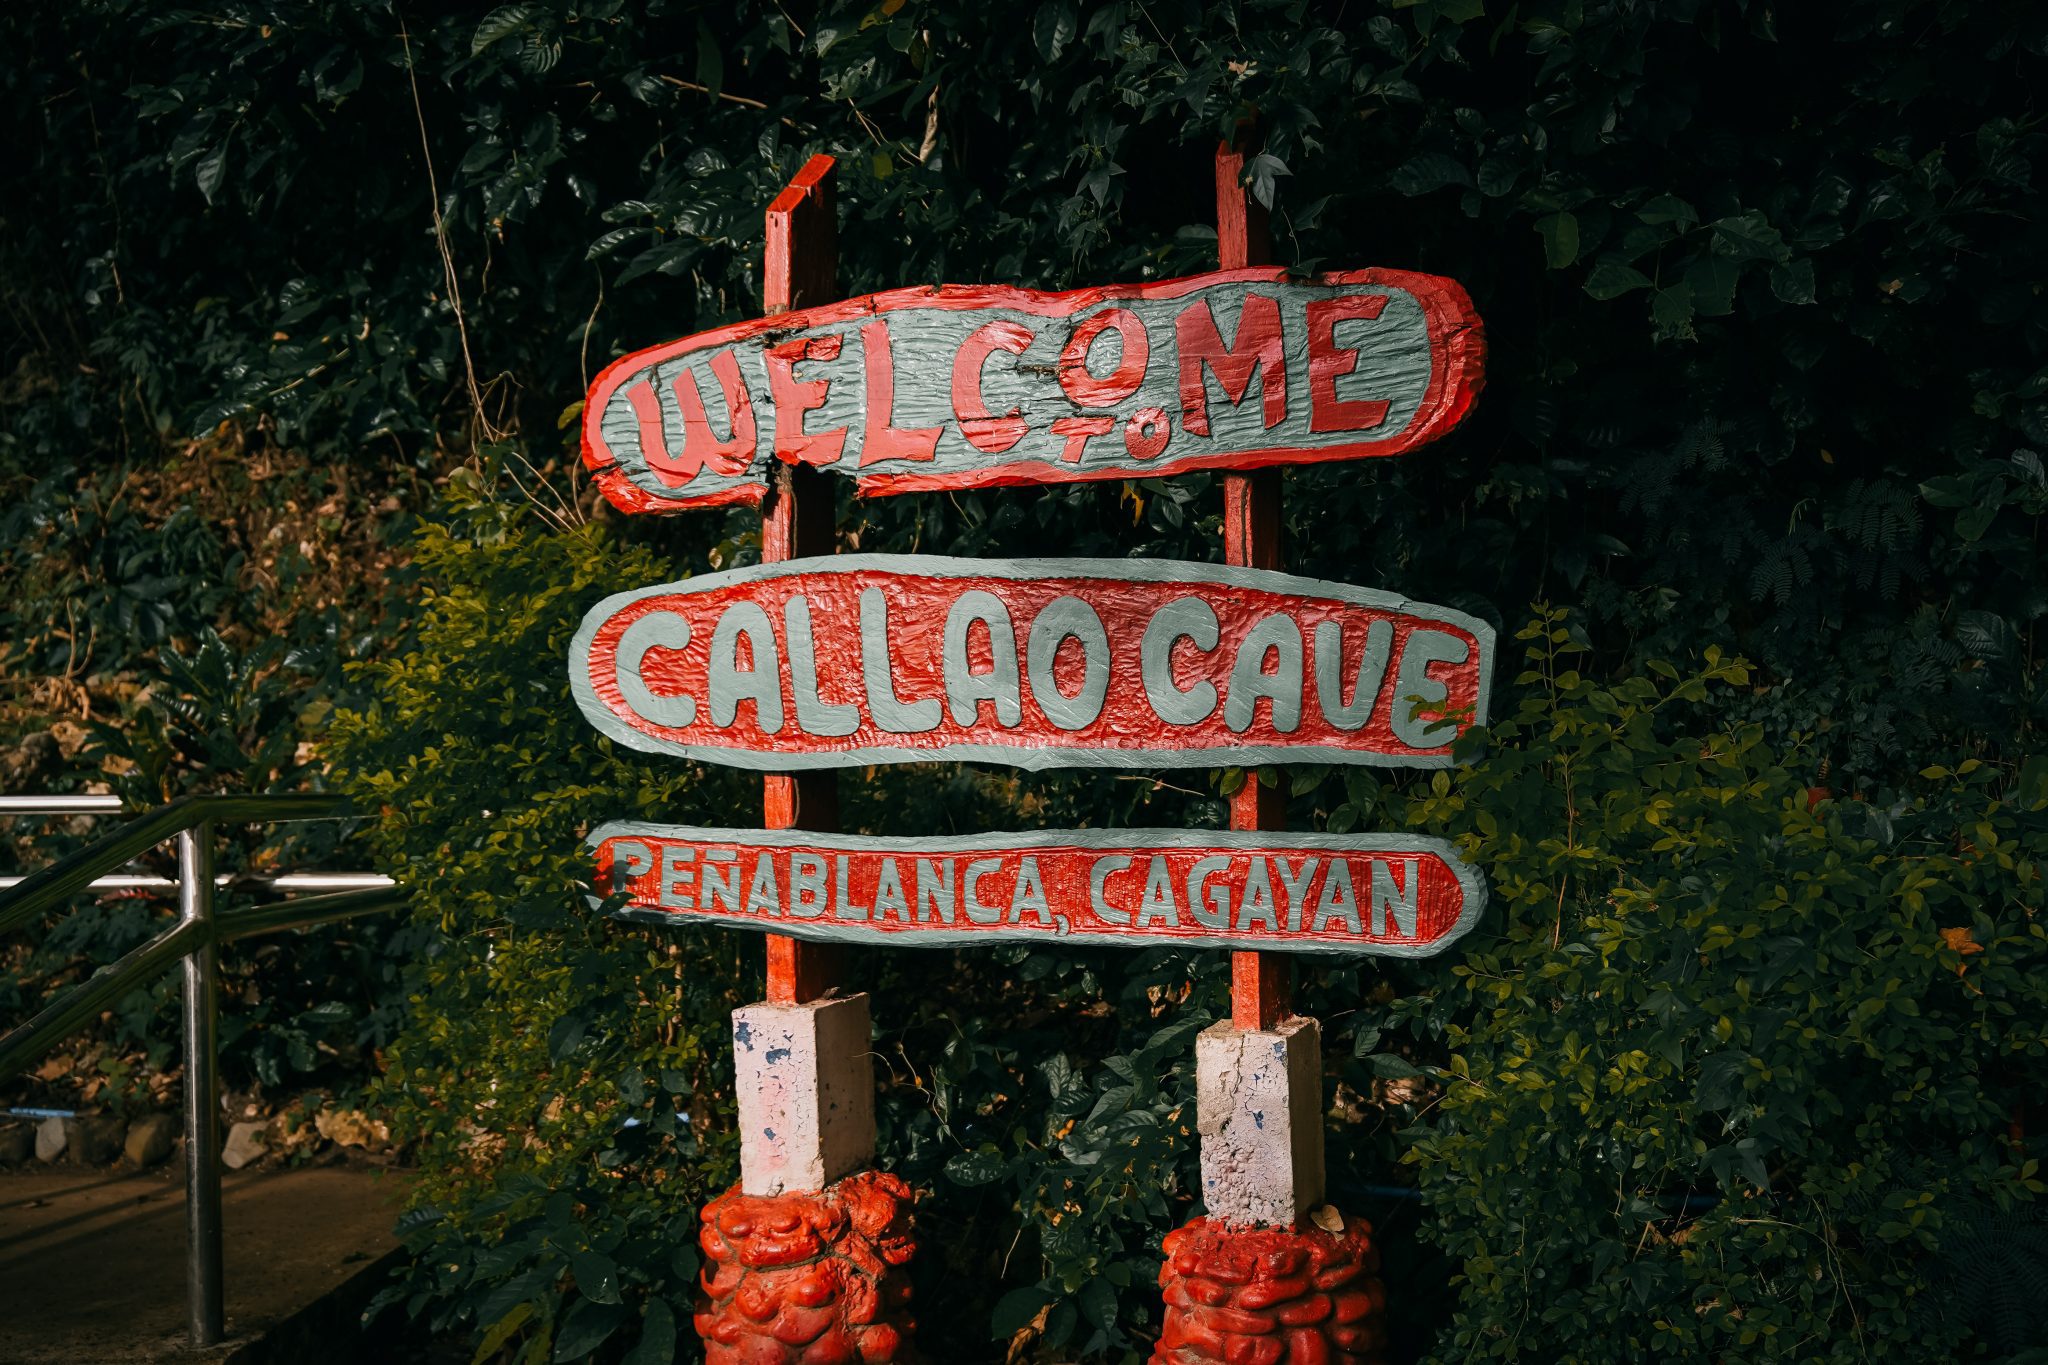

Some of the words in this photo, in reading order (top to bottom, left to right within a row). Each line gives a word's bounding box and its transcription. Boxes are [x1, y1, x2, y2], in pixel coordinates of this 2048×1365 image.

[626, 292, 1390, 488] WELCOME
[616, 587, 1111, 736] CALLAO
[1141, 597, 1470, 748] CAVE
[1090, 855, 1419, 937] CAGAYAN
